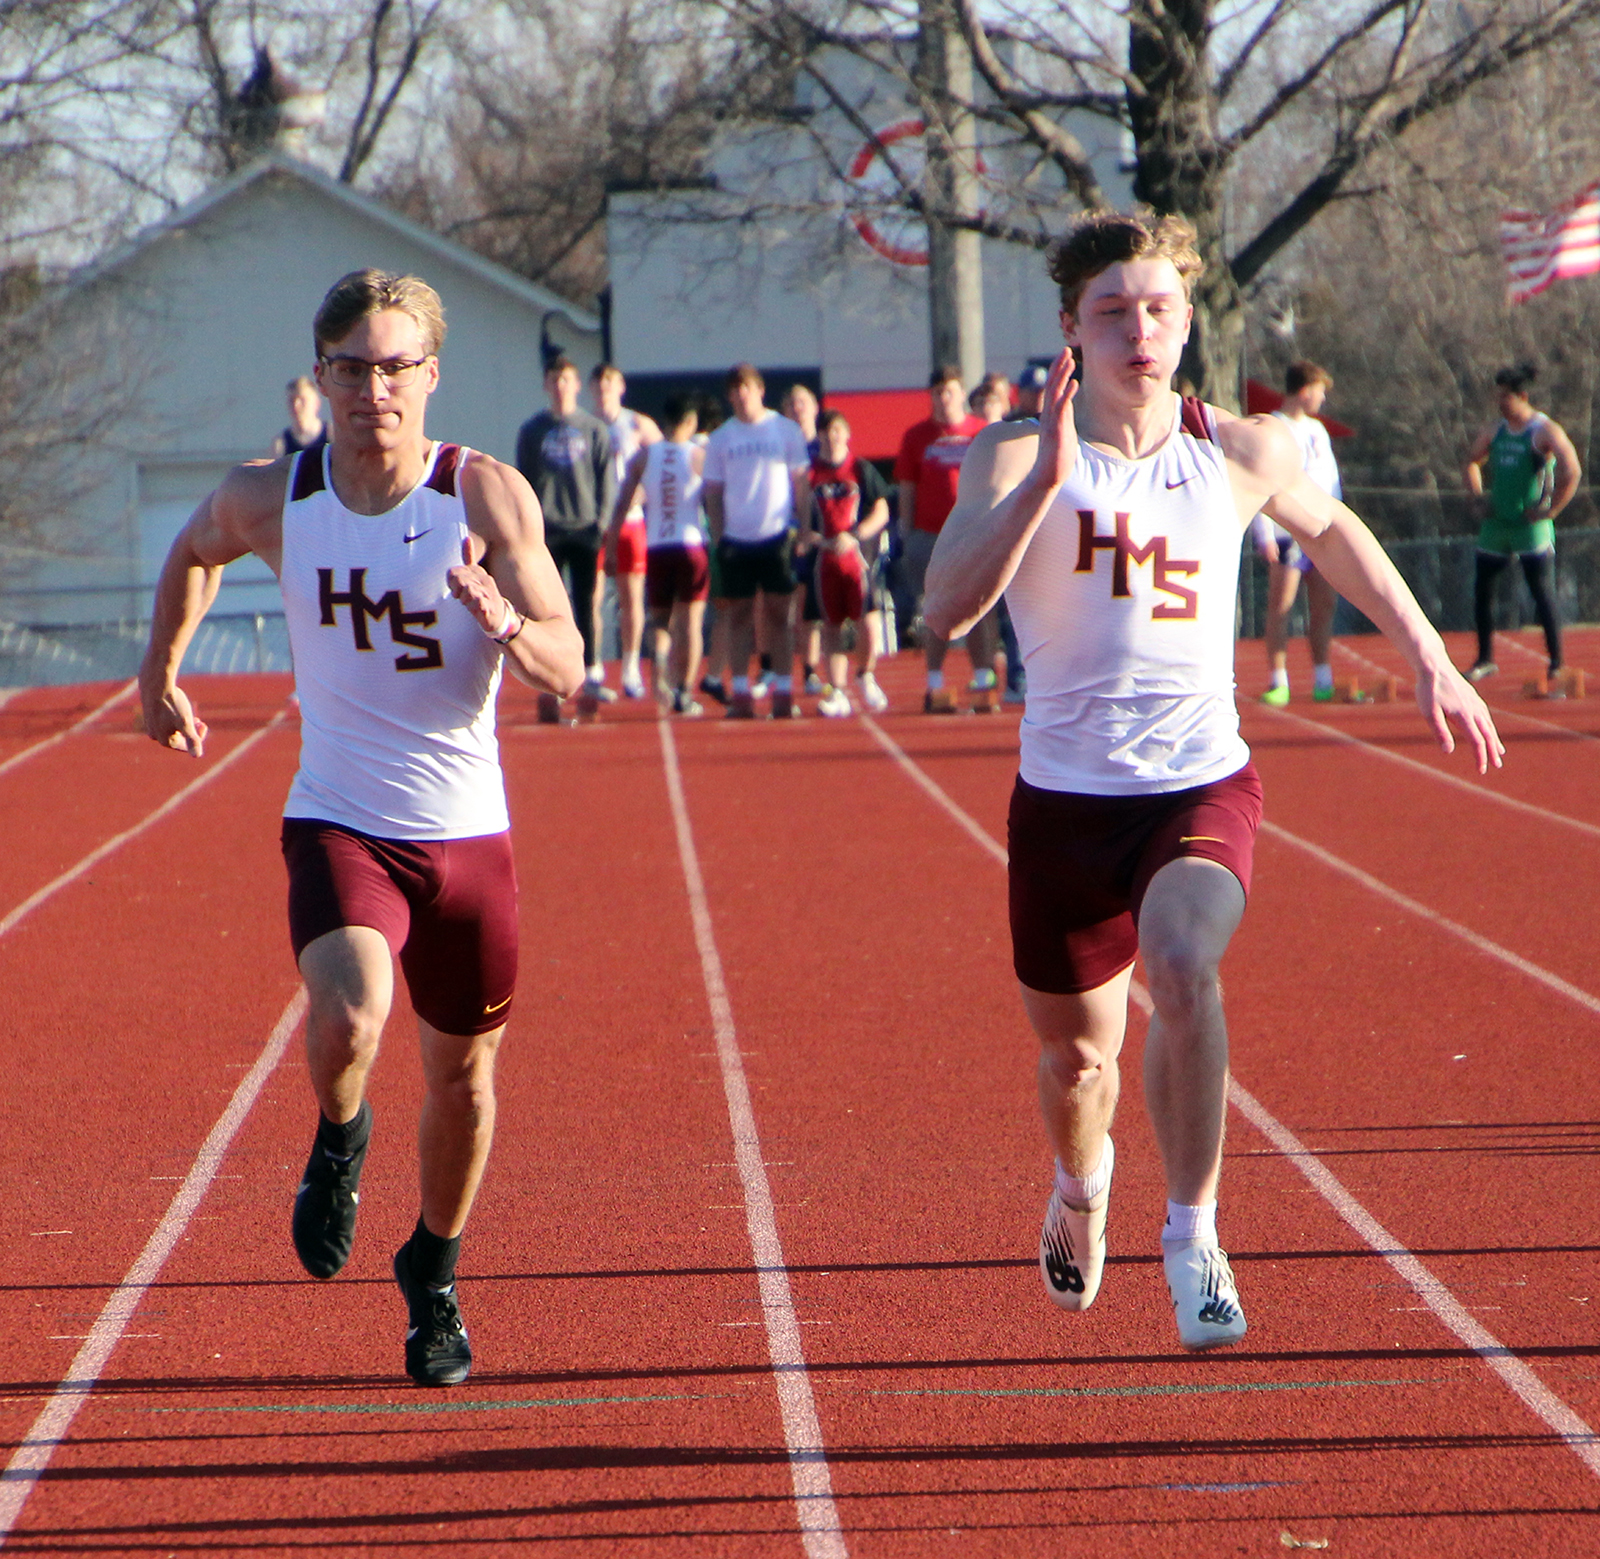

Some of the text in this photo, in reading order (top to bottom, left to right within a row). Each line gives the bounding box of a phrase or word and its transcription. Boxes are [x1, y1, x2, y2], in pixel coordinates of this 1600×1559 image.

[660, 448, 678, 538] HAWKS
[1073, 509, 1200, 621] HMS
[316, 567, 444, 672] HMS
